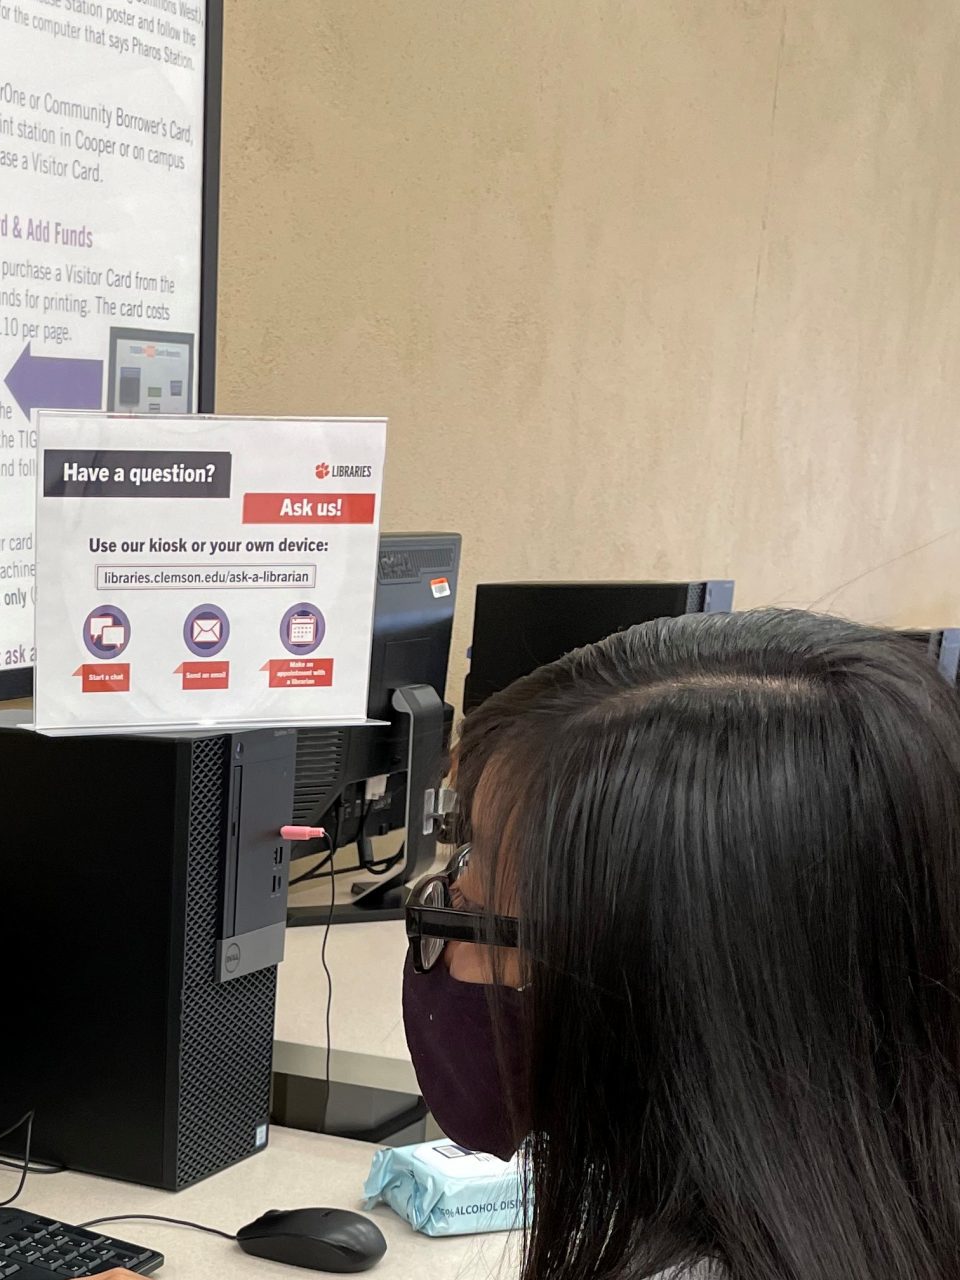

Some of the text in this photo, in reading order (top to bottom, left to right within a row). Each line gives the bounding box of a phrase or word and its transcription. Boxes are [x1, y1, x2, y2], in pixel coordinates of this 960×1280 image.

[28, 93, 40, 110] or
[44, 92, 112, 129] Community
[116, 107, 167, 137] Borrower's
[169, 120, 194, 146] Card,
[17, 120, 55, 145] station
[60, 126, 71, 147] in
[75, 130, 116, 156] Cooper
[120, 142, 130, 158] or
[133, 144, 144, 161] on
[148, 147, 185, 171] campus
[21, 154, 28, 170] a
[32, 151, 68, 177] Visitor
[72, 159, 104, 183] Card.
[12, 215, 22, 240] &
[26, 218, 50, 243] Add
[54, 222, 93, 248] Funds
[2, 259, 52, 281] purchase
[55, 267, 61, 282] a
[65, 263, 103, 286] Visitor
[106, 268, 132, 289] Card
[135, 271, 157, 291] from
[160, 274, 175, 294] the
[25, 289, 39, 310] for
[43, 292, 91, 318] printing.
[95, 295, 116, 316] The
[120, 299, 142, 318] card
[146, 302, 170, 321] costs
[22, 323, 39, 342] per
[43, 324, 72, 344] page.
[18, 430, 37, 448] TIG
[63, 462, 215, 487] Have a question?
[331, 465, 372, 479] LIBRARIES
[280, 499, 342, 517] Ask us!
[9, 533, 32, 552] card
[89, 537, 329, 556] Use our kiosk or your own device:
[104, 570, 309, 585] libraries.clemson.edu/ask-a-librarian
[4, 587, 27, 608] only
[5, 644, 26, 666] ask
[455, 1202, 498, 1216] ALCOHOL
